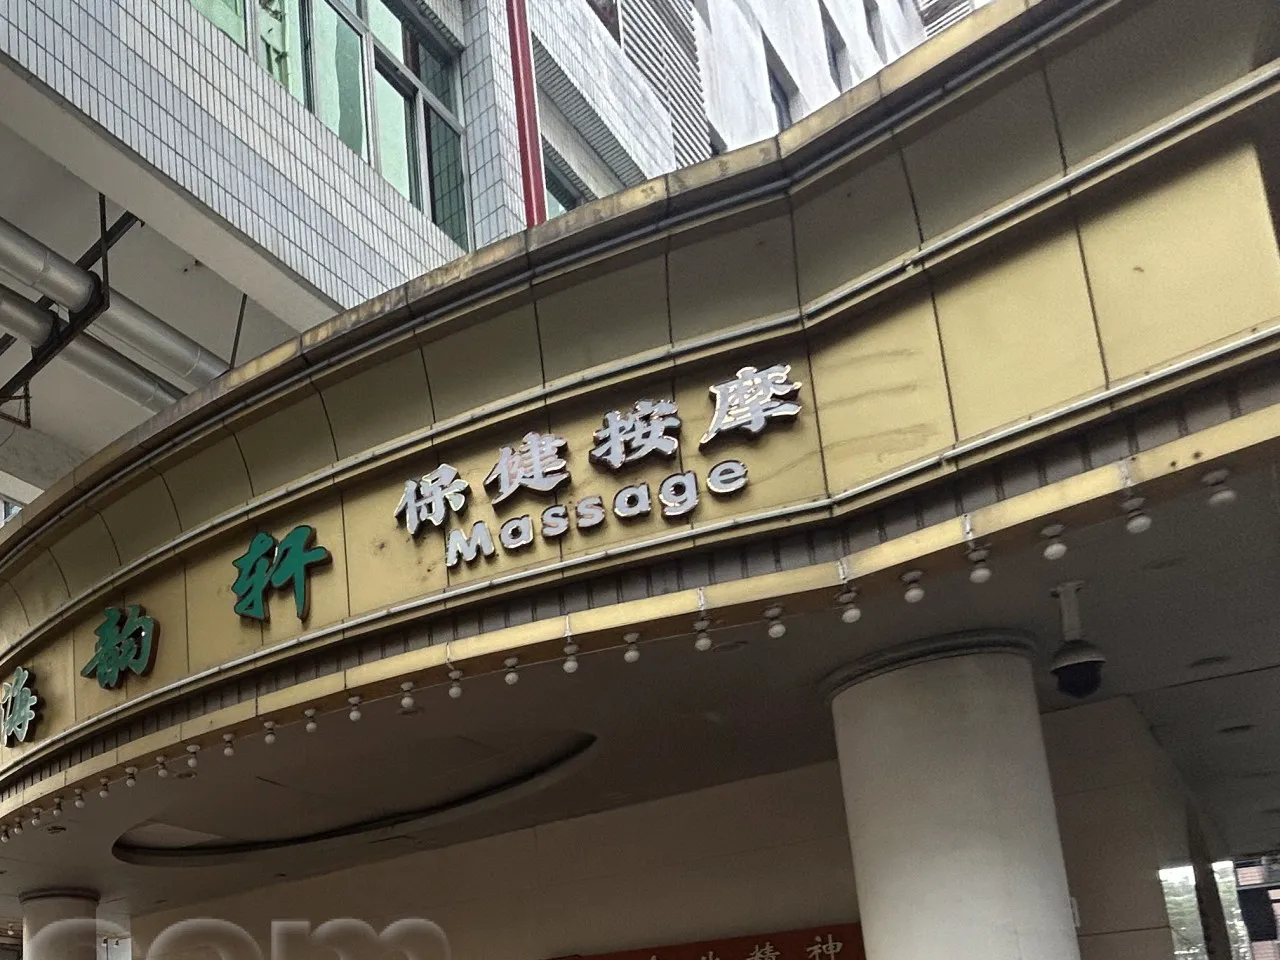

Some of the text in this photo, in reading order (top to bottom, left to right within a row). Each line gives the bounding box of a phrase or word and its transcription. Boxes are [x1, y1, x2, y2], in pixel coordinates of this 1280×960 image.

[393, 363, 803, 536] 保健按摩
[444, 458, 750, 568] Massage
[0, 524, 333, 748] 海韵轩
